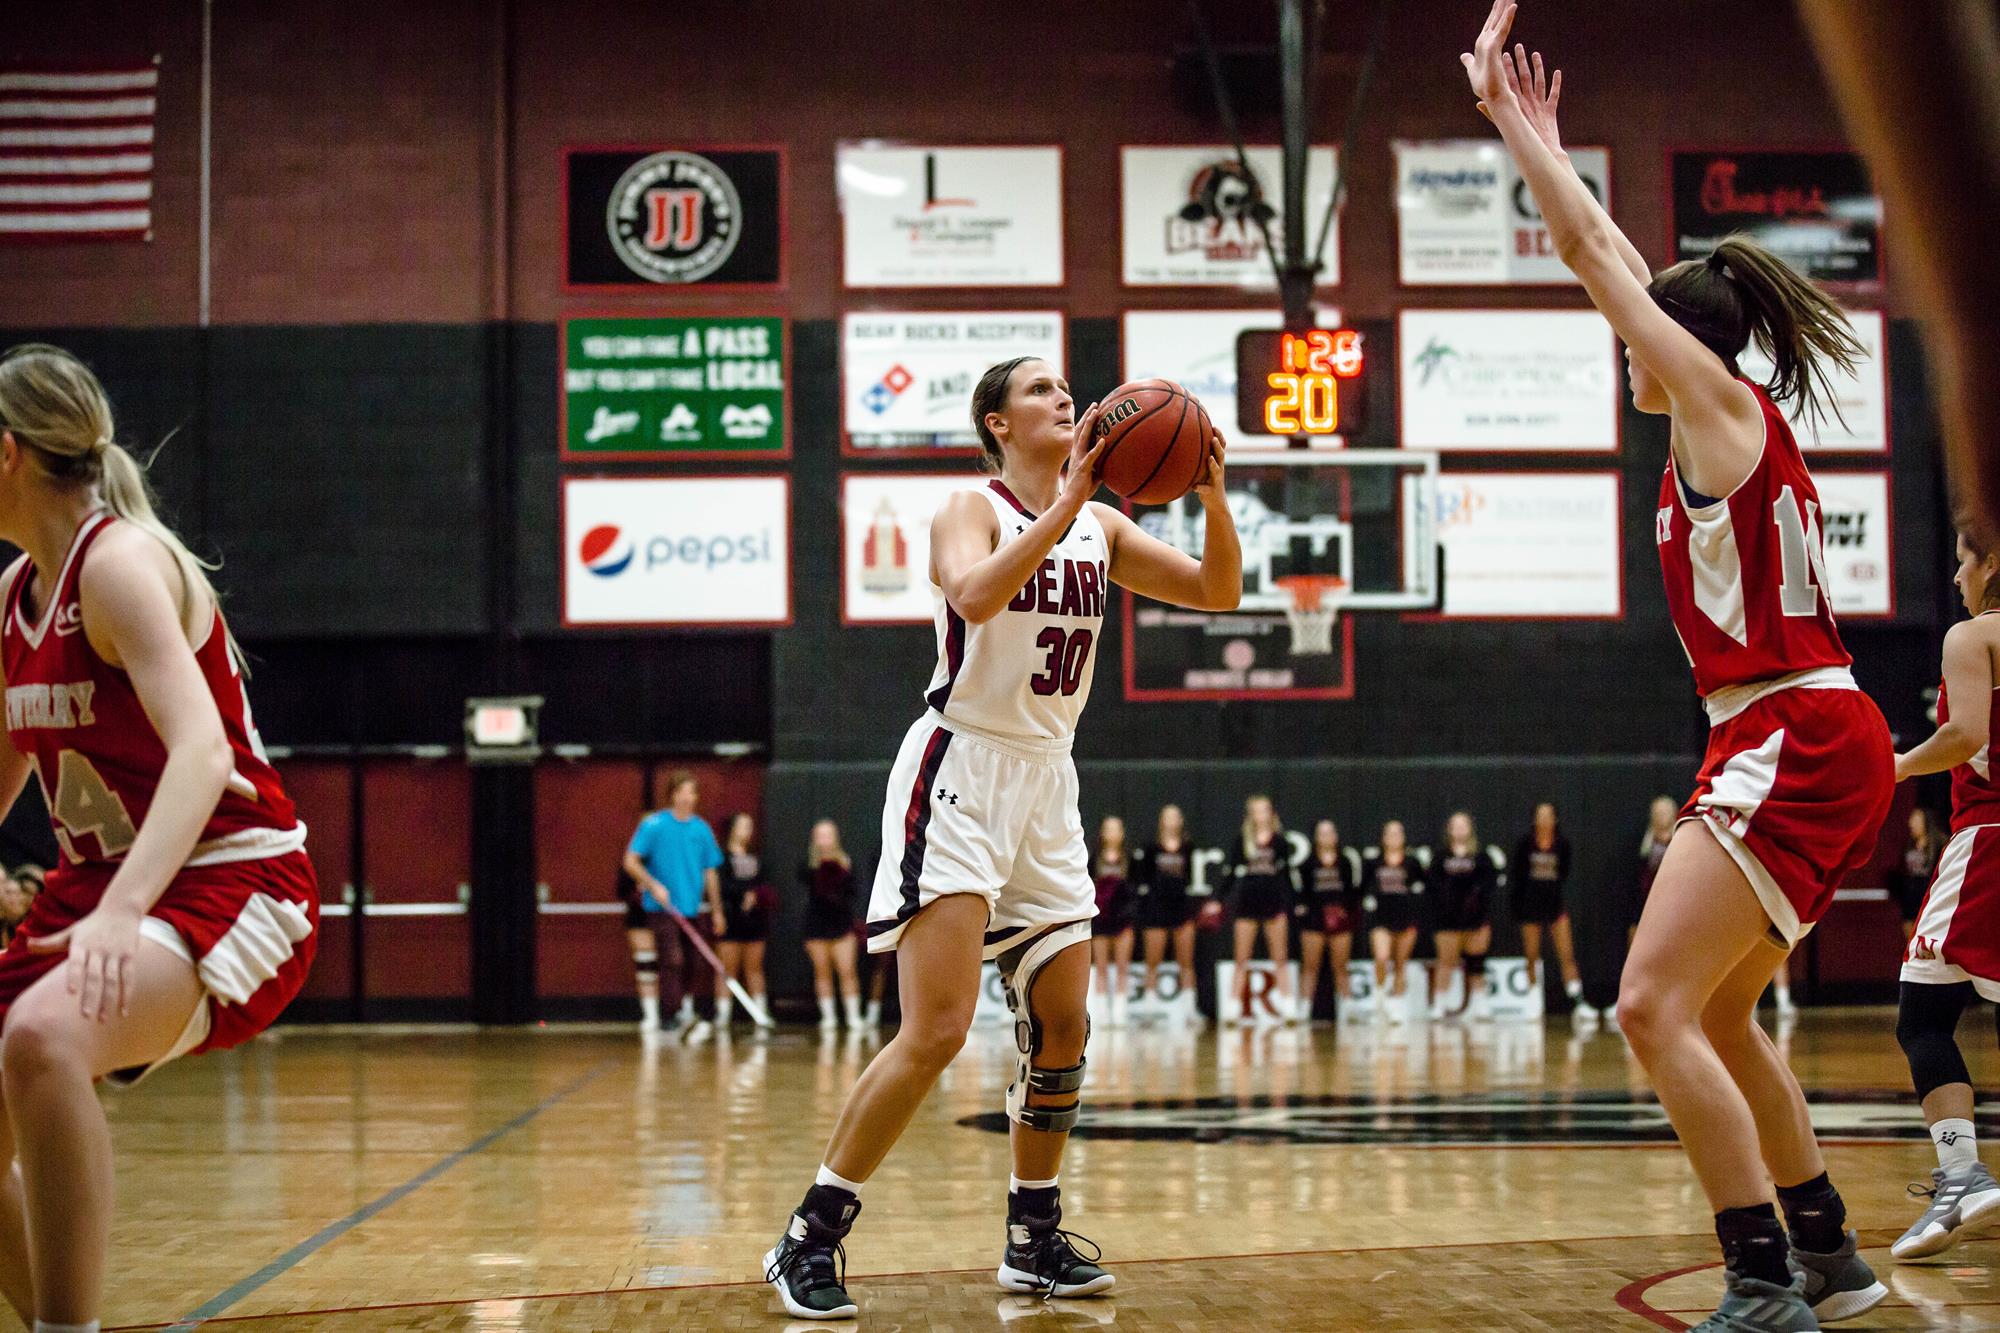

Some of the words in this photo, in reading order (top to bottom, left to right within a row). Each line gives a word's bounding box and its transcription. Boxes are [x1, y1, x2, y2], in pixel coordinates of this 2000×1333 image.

[683, 327, 701, 358] A
[704, 326, 769, 358] PASS
[1264, 373, 1338, 434] 20
[645, 527, 771, 570] pepsi
[1079, 534, 1093, 542] SAC
[1030, 626, 1093, 697] 30
[27, 749, 139, 865] 4
[1239, 967, 1284, 1020] R
